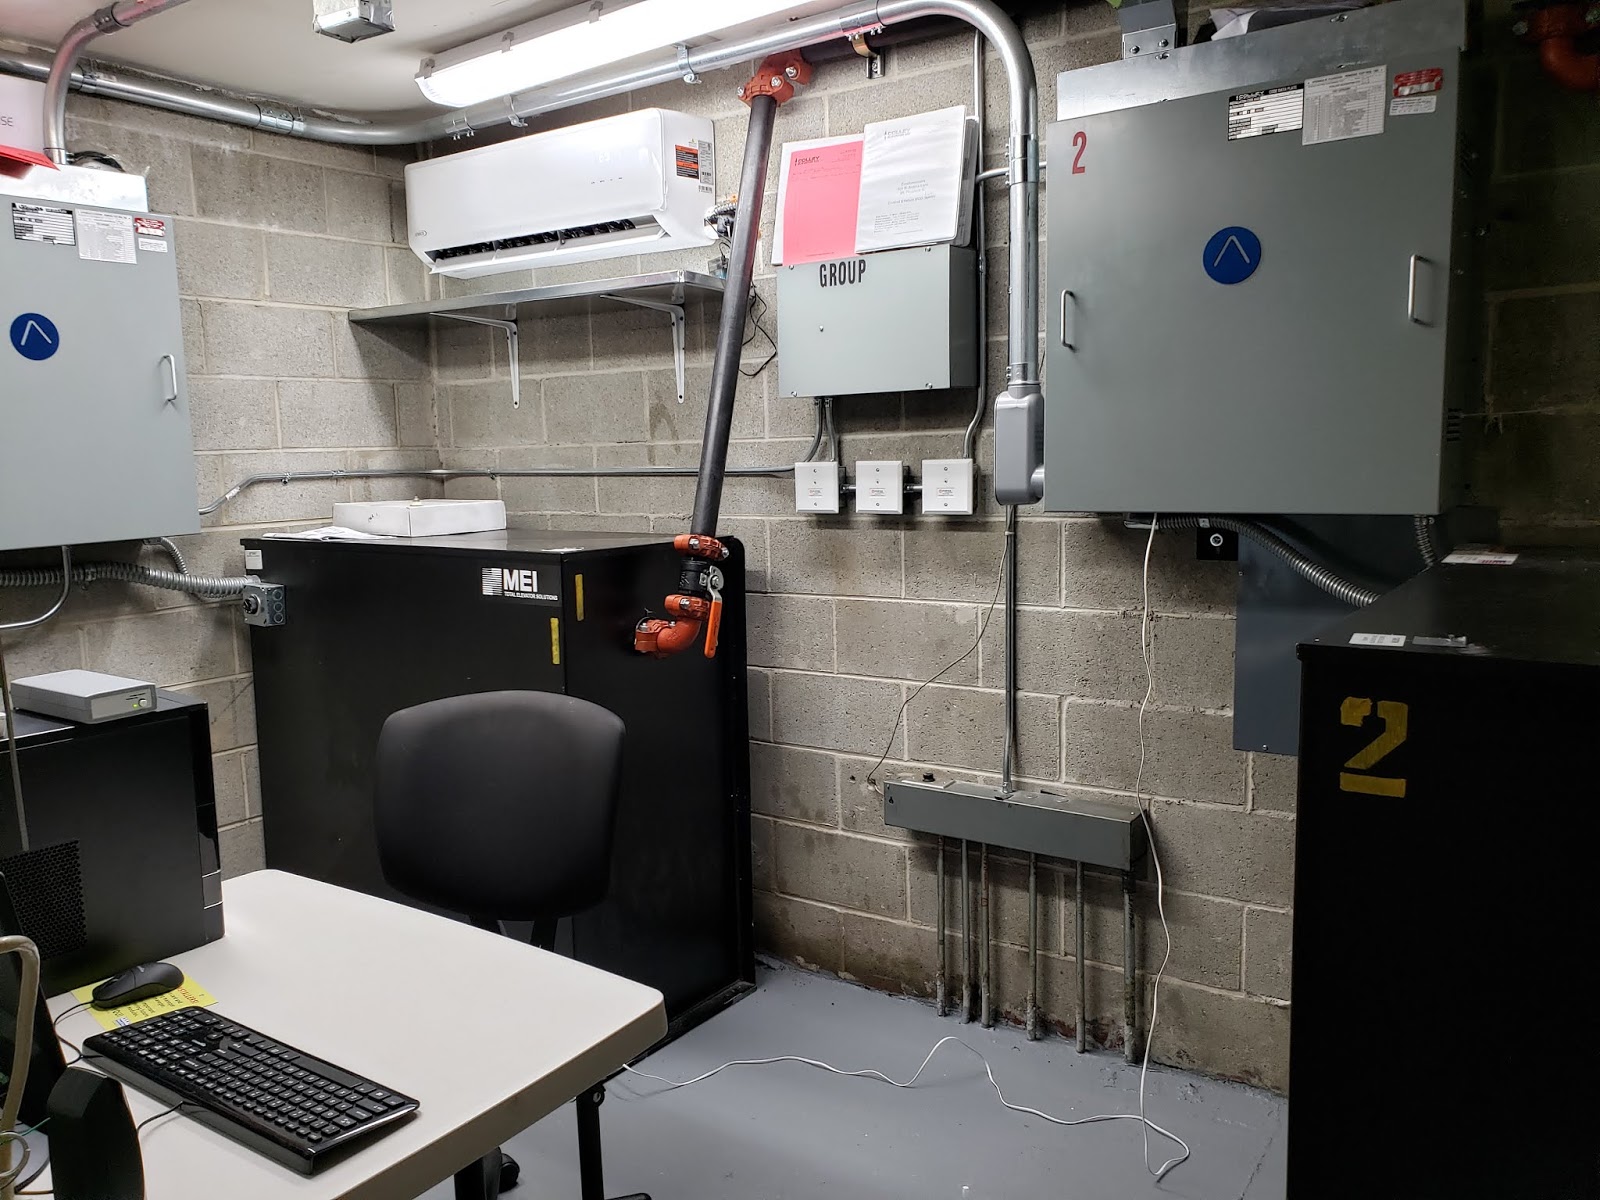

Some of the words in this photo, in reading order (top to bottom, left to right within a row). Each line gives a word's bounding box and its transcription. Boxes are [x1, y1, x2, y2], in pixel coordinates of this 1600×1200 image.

[1072, 131, 1087, 174] 2
[820, 259, 866, 287] GROUP
[503, 569, 537, 592] MEI
[1340, 696, 1409, 798] 2
